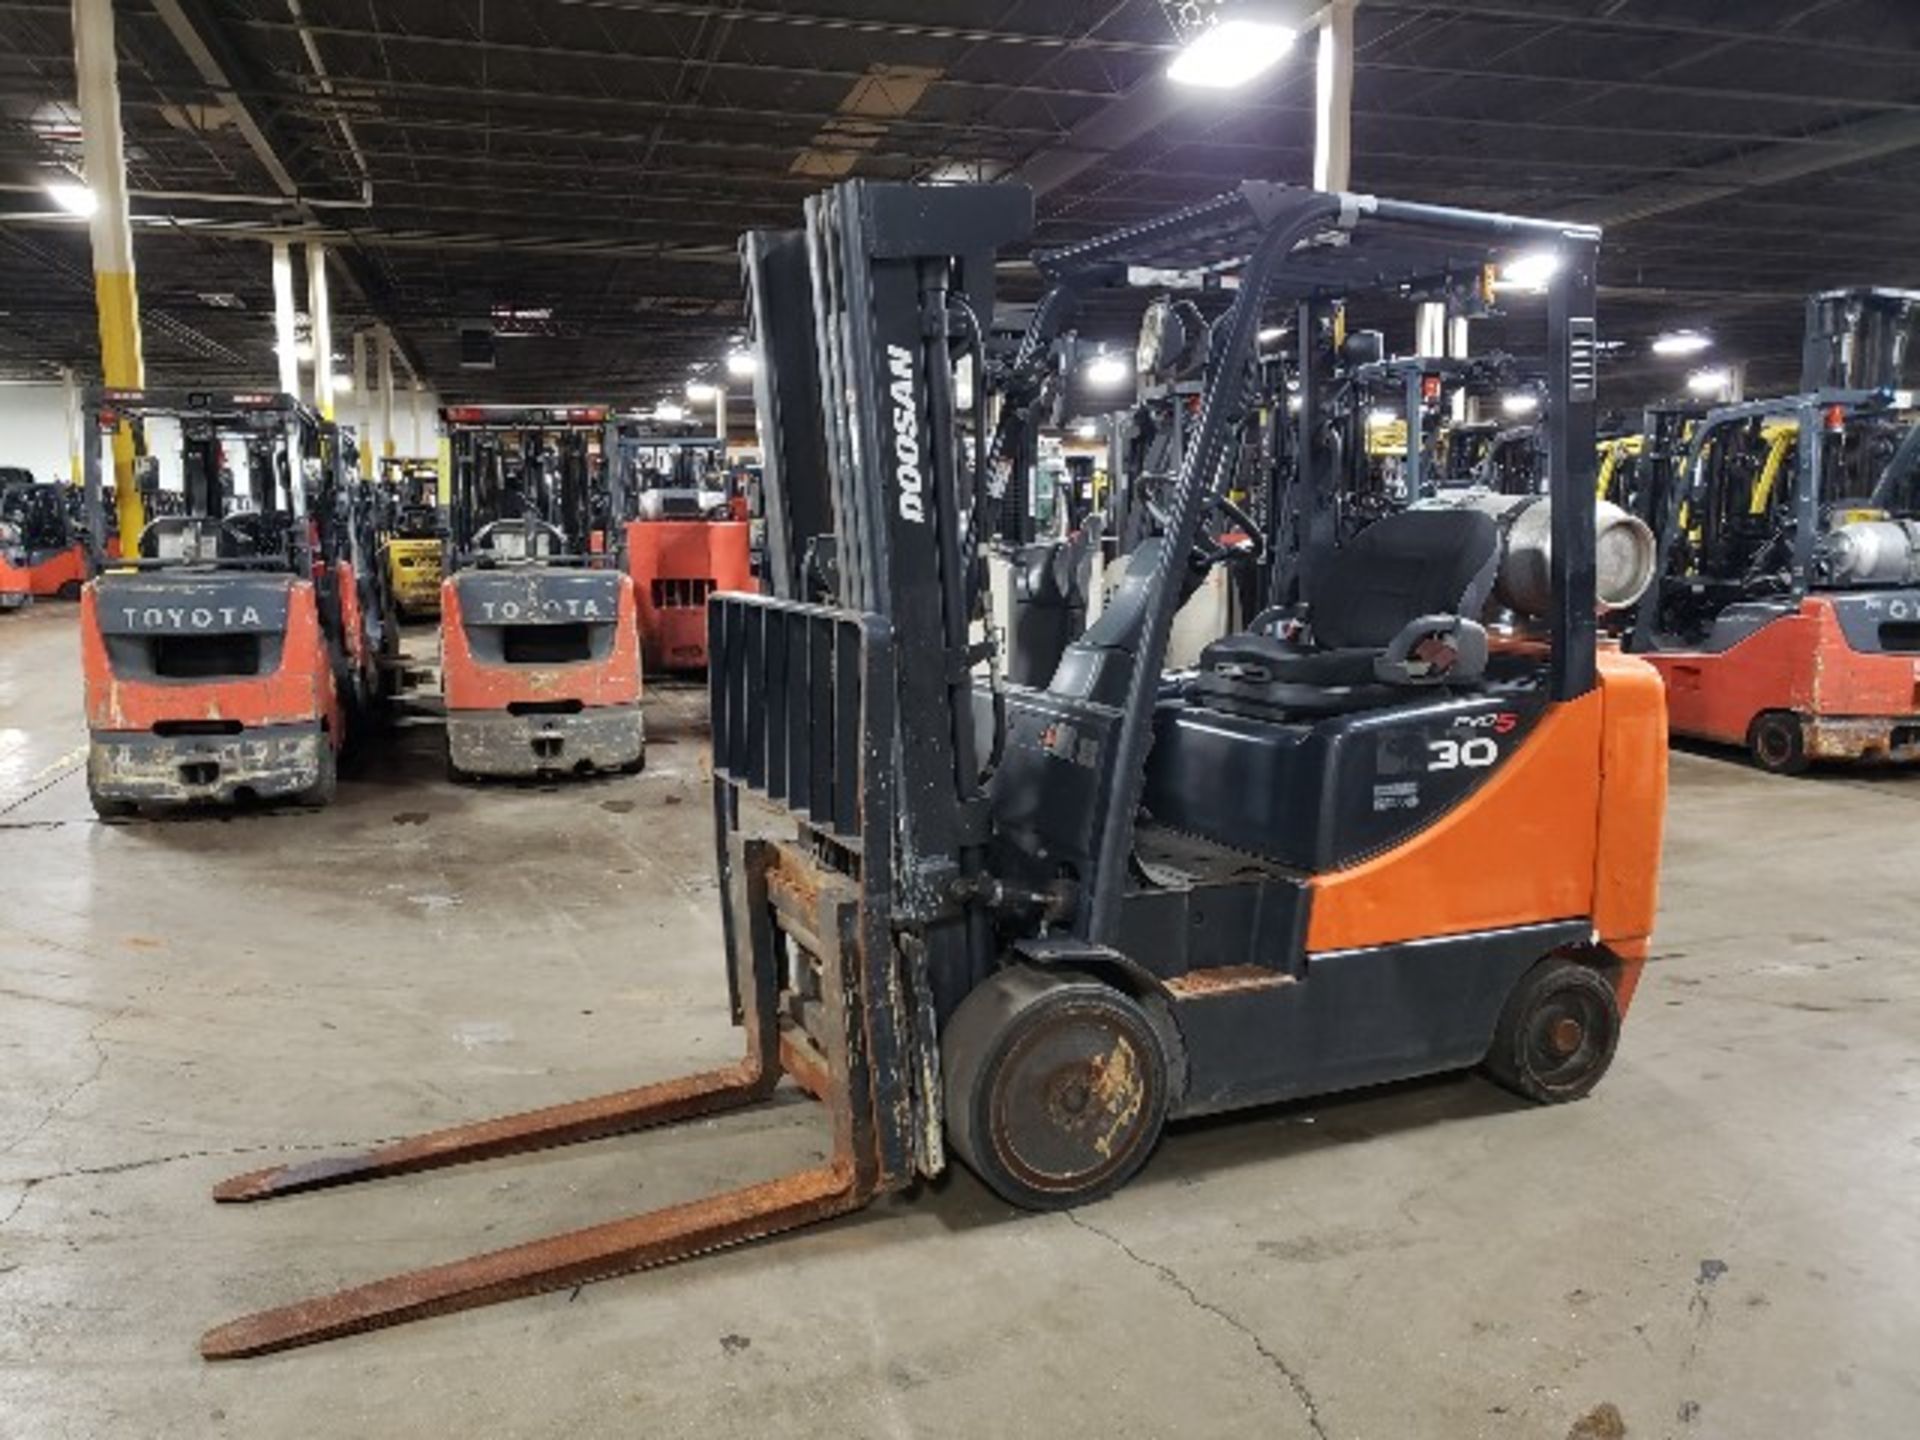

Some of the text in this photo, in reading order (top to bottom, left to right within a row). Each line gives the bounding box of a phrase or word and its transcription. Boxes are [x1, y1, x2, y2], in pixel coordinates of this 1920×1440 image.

[887, 344, 925, 523] DOOSAN
[123, 606, 262, 628] TOYOTA
[482, 600, 600, 618] TOOTA
[1427, 737, 1498, 772] 30
